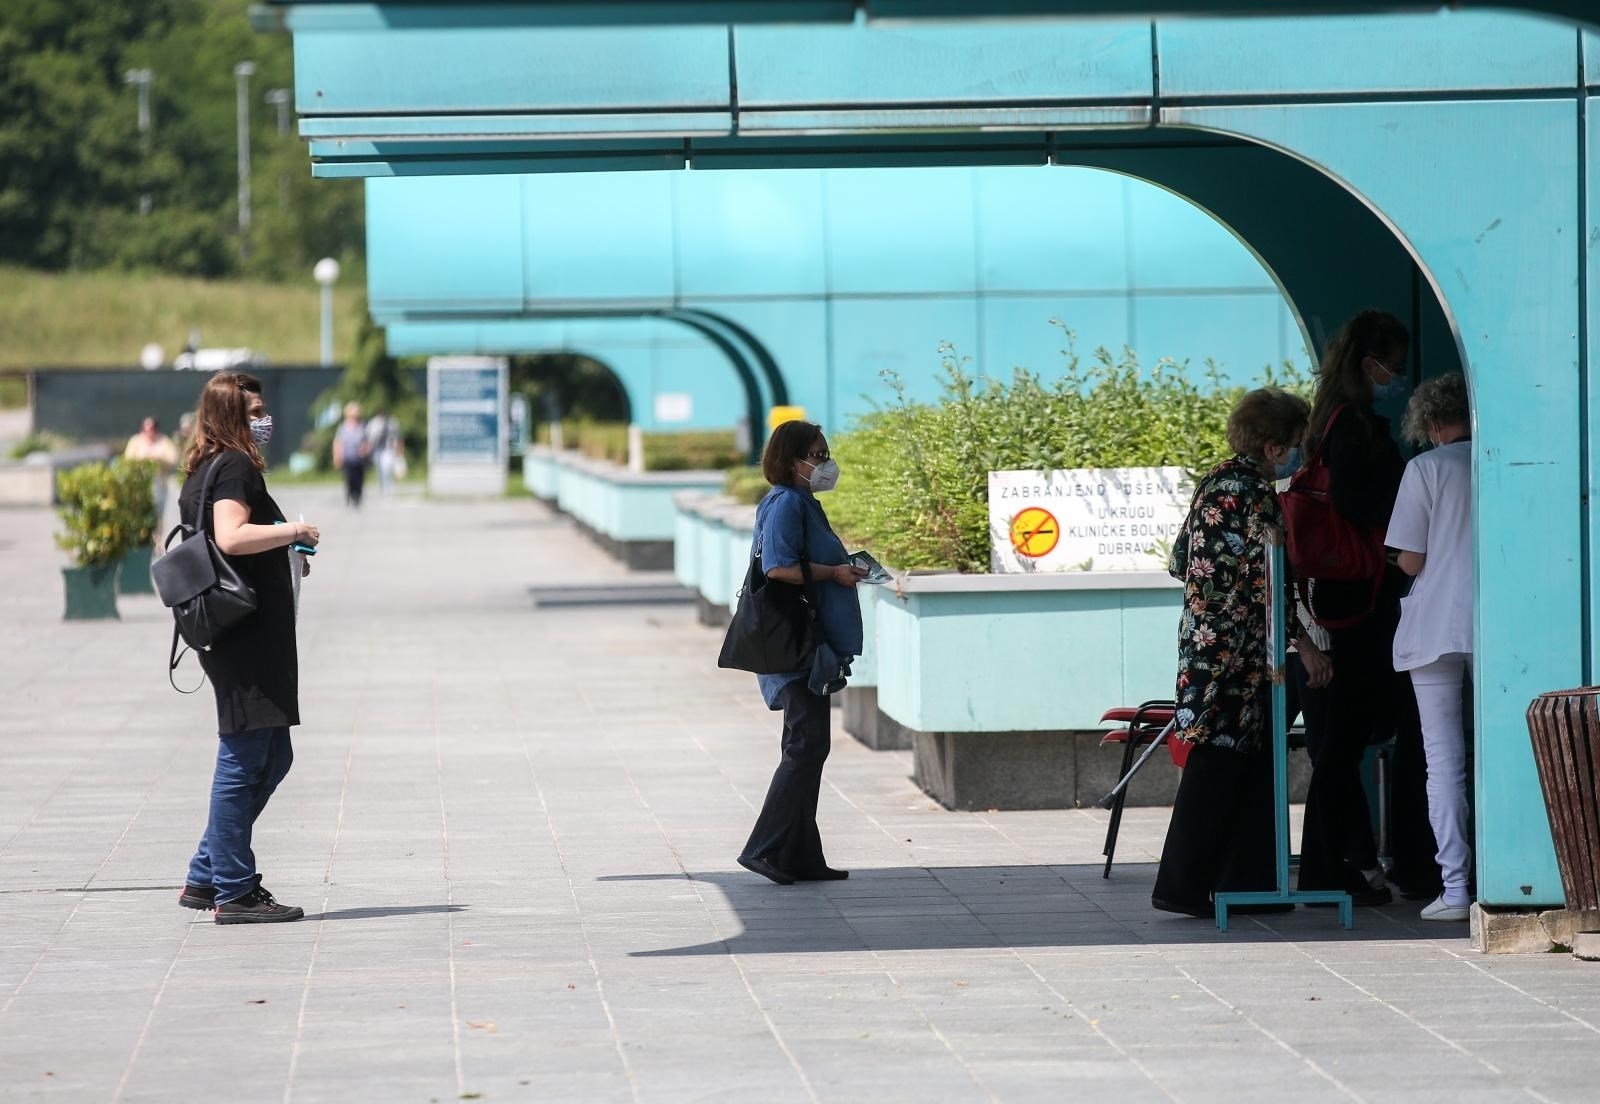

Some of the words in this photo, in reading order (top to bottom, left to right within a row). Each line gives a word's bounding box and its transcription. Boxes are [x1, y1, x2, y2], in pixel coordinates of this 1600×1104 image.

[1001, 484, 1106, 499] ZABRANJENO
[1098, 508, 1106, 520] U
[1109, 506, 1155, 519] KRUGU
[1068, 522, 1127, 538] KLINIČKE
